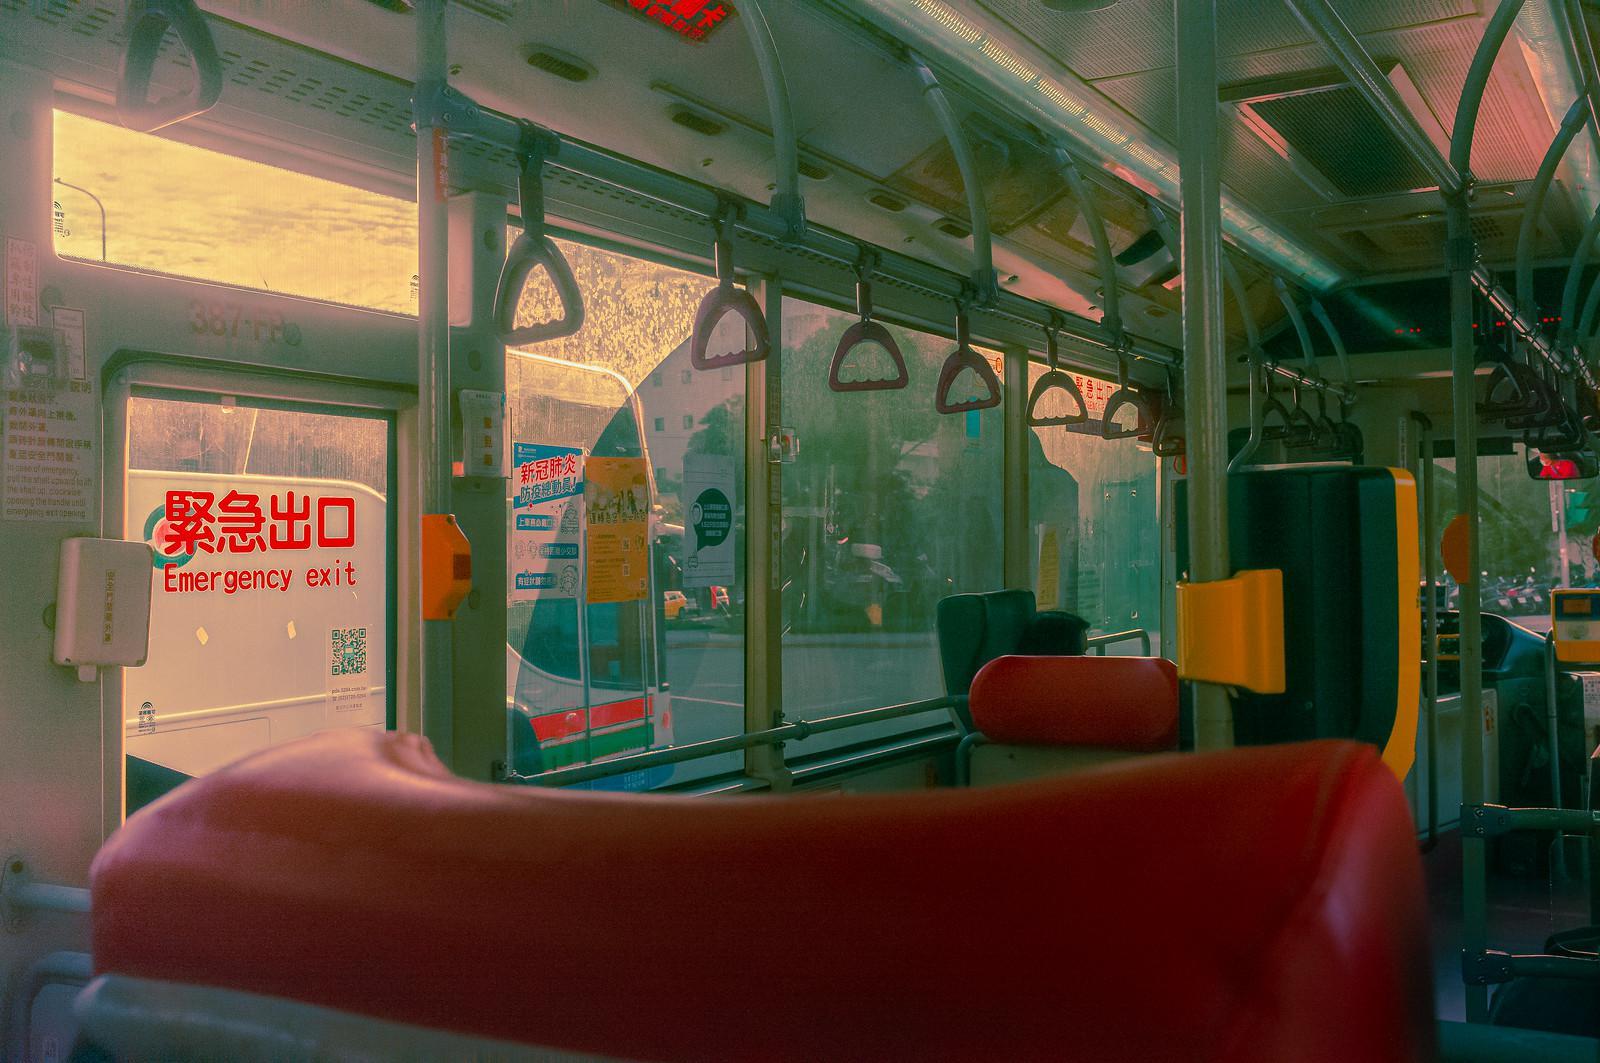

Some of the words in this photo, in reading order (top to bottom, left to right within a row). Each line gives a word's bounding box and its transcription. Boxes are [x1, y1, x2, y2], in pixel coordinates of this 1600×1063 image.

[521, 453, 576, 484] 新冠肺炎
[520, 476, 577, 502] 防疫總動員!
[164, 489, 356, 555] 緊急出口
[164, 563, 293, 595] Emergency
[306, 559, 357, 587] exit
